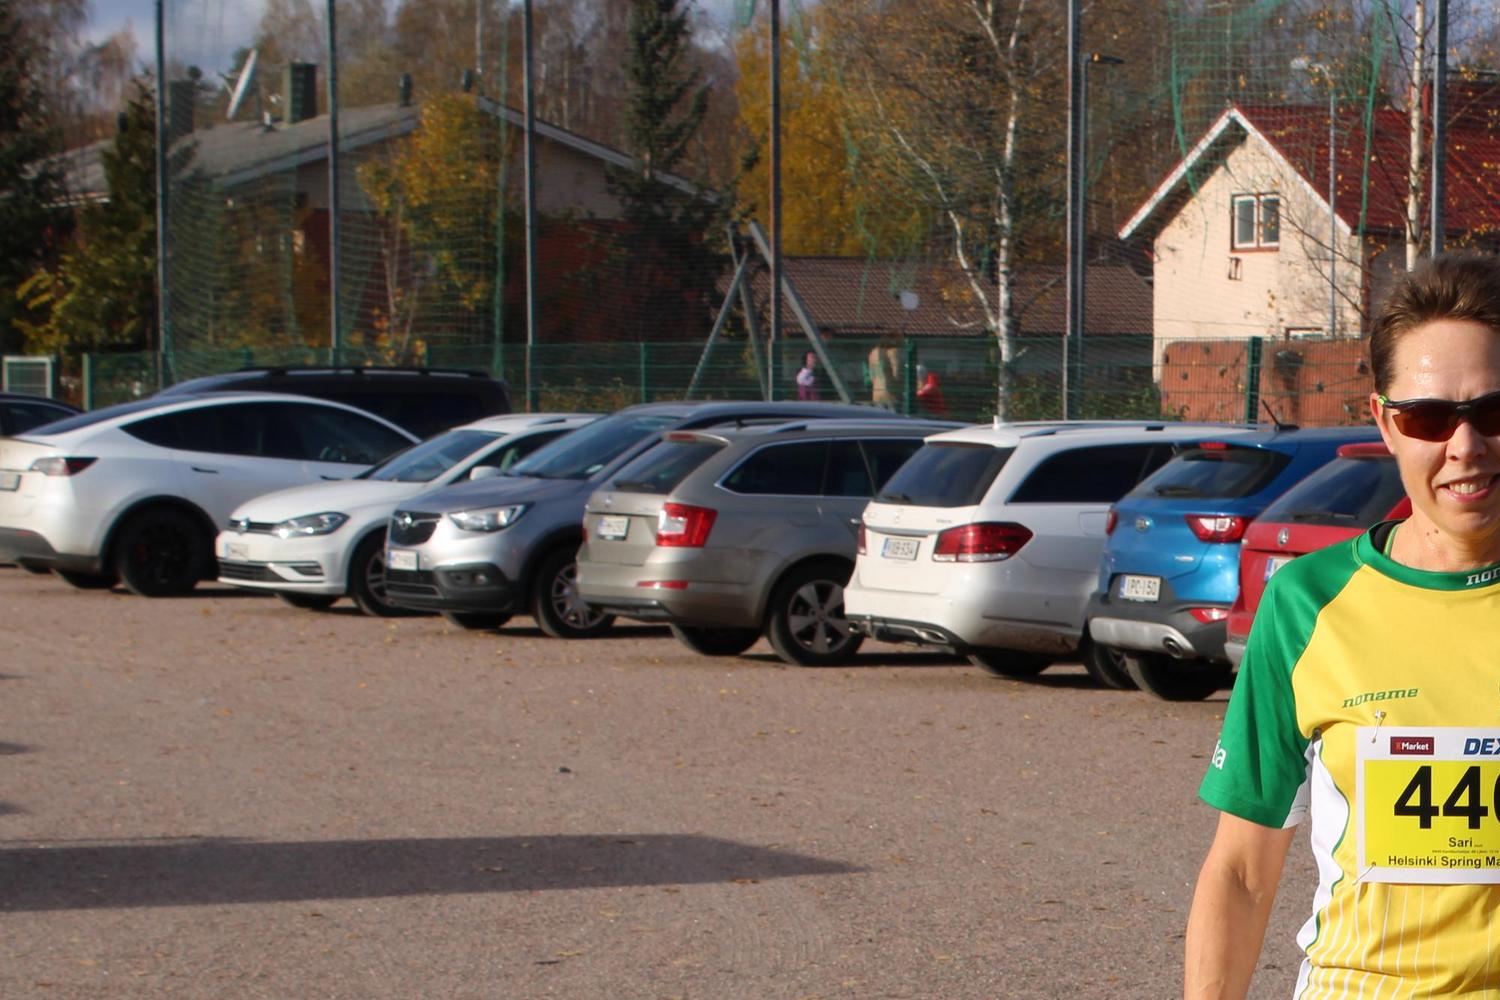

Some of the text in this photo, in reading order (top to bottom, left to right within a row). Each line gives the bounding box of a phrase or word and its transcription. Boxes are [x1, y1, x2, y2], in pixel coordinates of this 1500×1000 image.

[1342, 688, 1419, 708] noname
[1448, 837, 1473, 848] Sari
[1388, 855, 1437, 866] Helsinki
[1441, 856, 1482, 869] Spring
